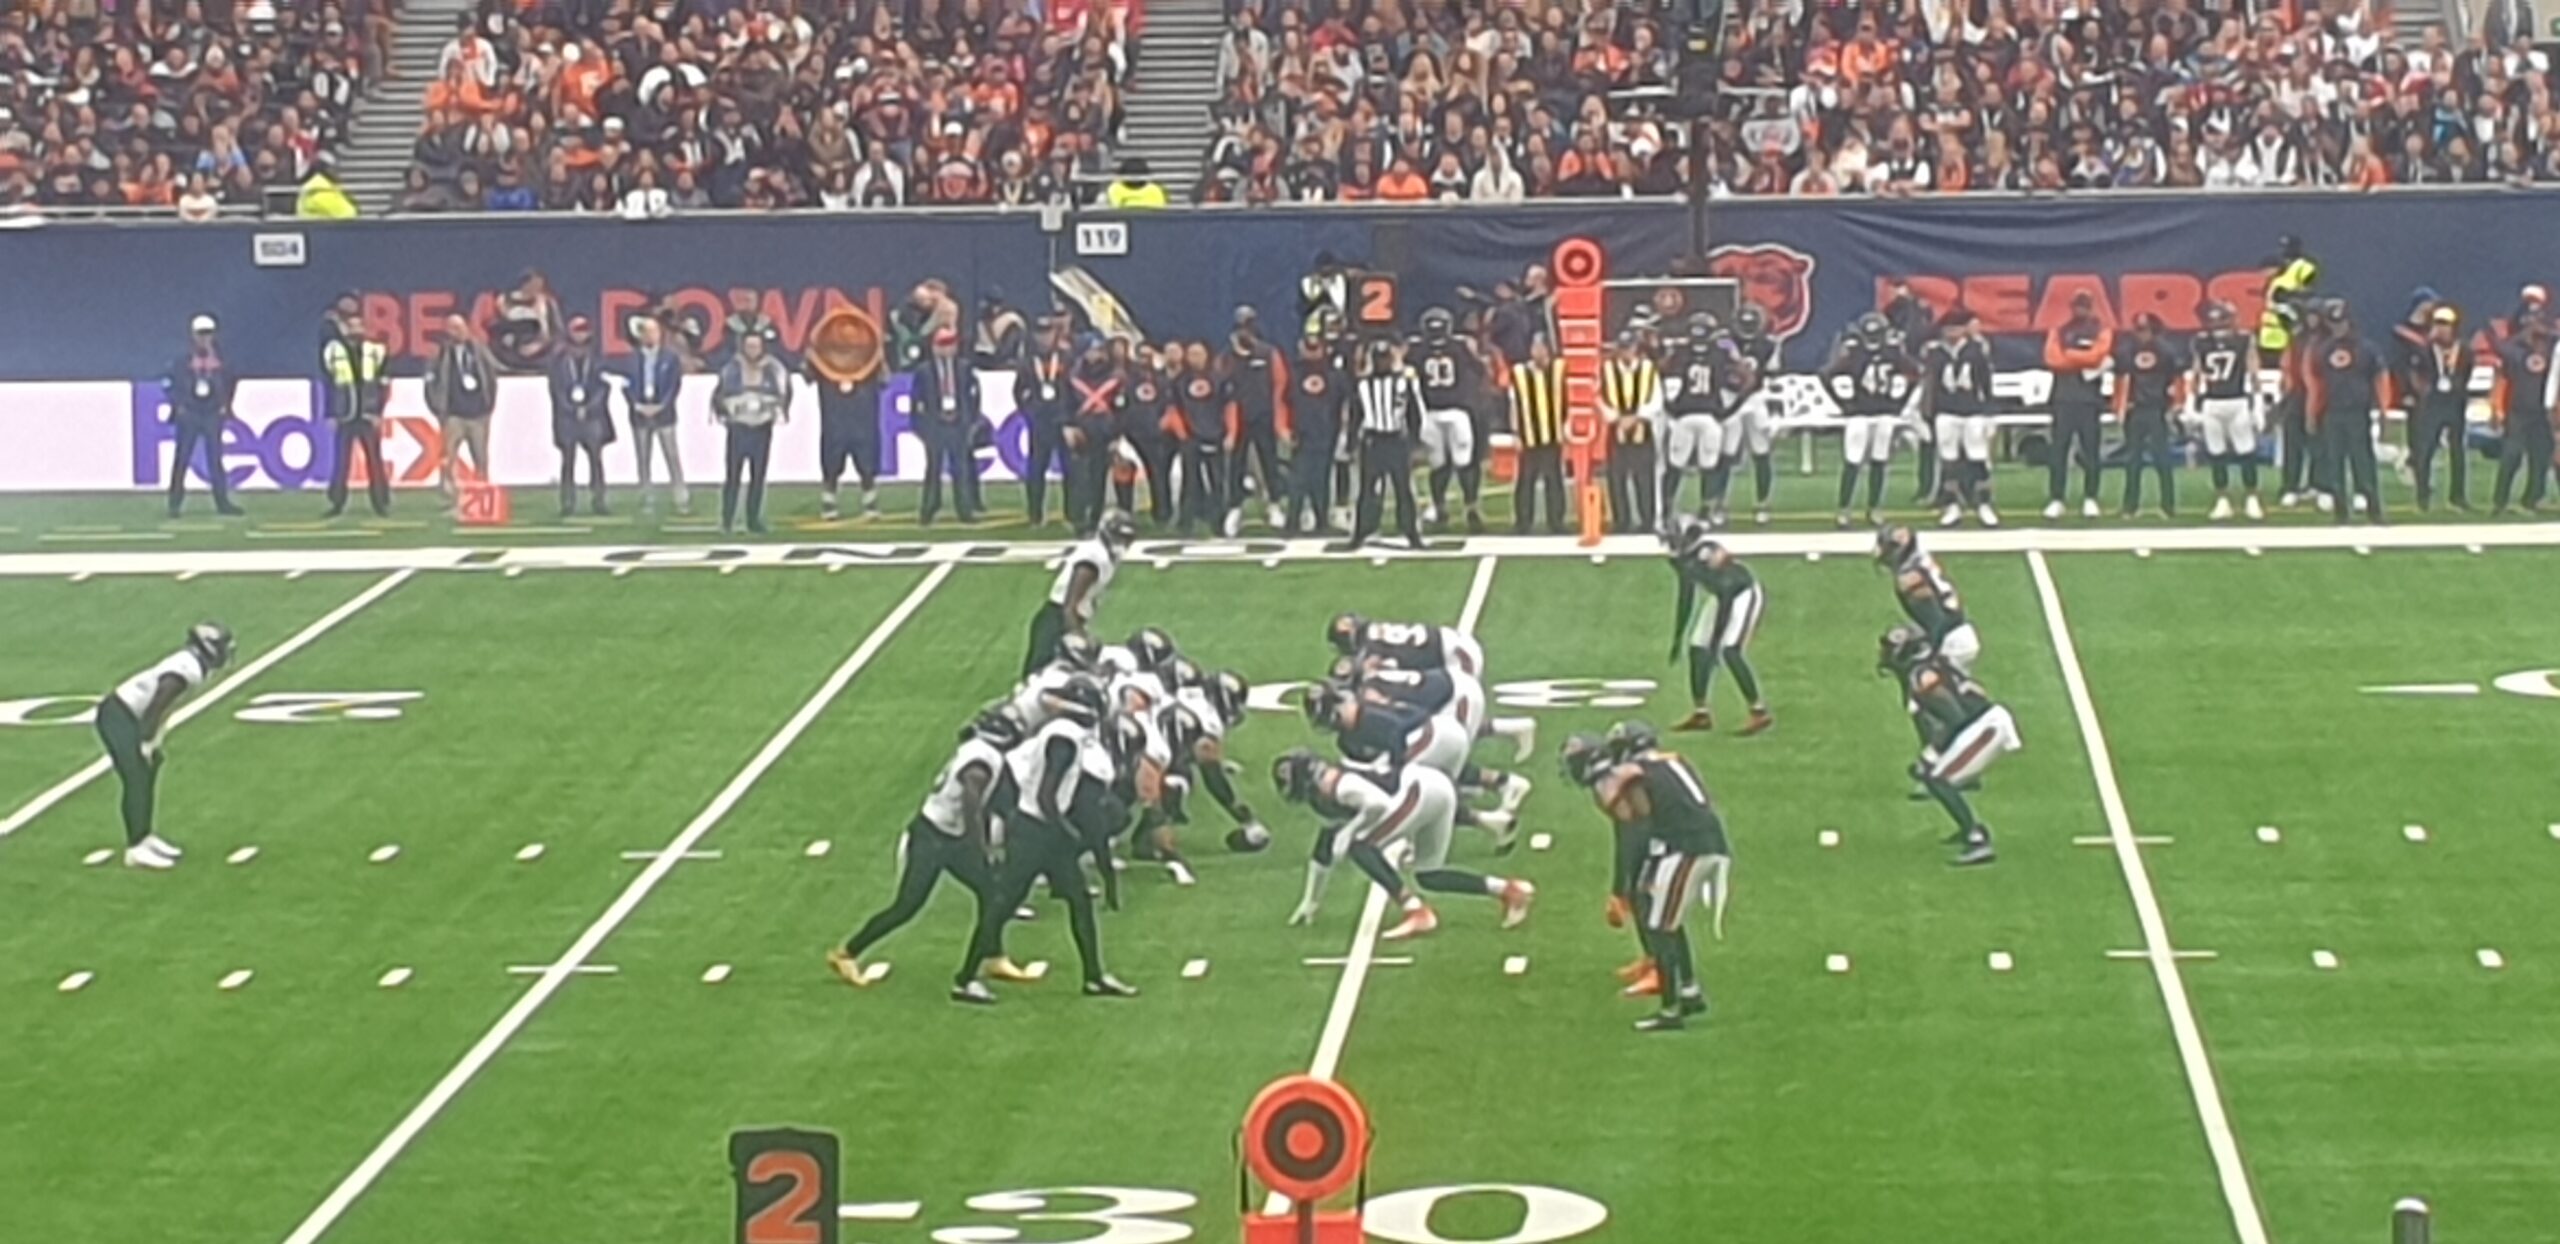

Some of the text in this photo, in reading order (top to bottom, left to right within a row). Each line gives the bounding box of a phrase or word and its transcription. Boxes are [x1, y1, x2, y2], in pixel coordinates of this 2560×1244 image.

[1083, 228, 1122, 248] 119
[1361, 281, 1393, 320] 2
[362, 290, 545, 357] BEA
[1861, 363, 1893, 393] 45
[1942, 362, 1972, 392] 44
[2206, 351, 2236, 381] 57
[463, 487, 495, 517] 20
[746, 1151, 822, 1244] 2
